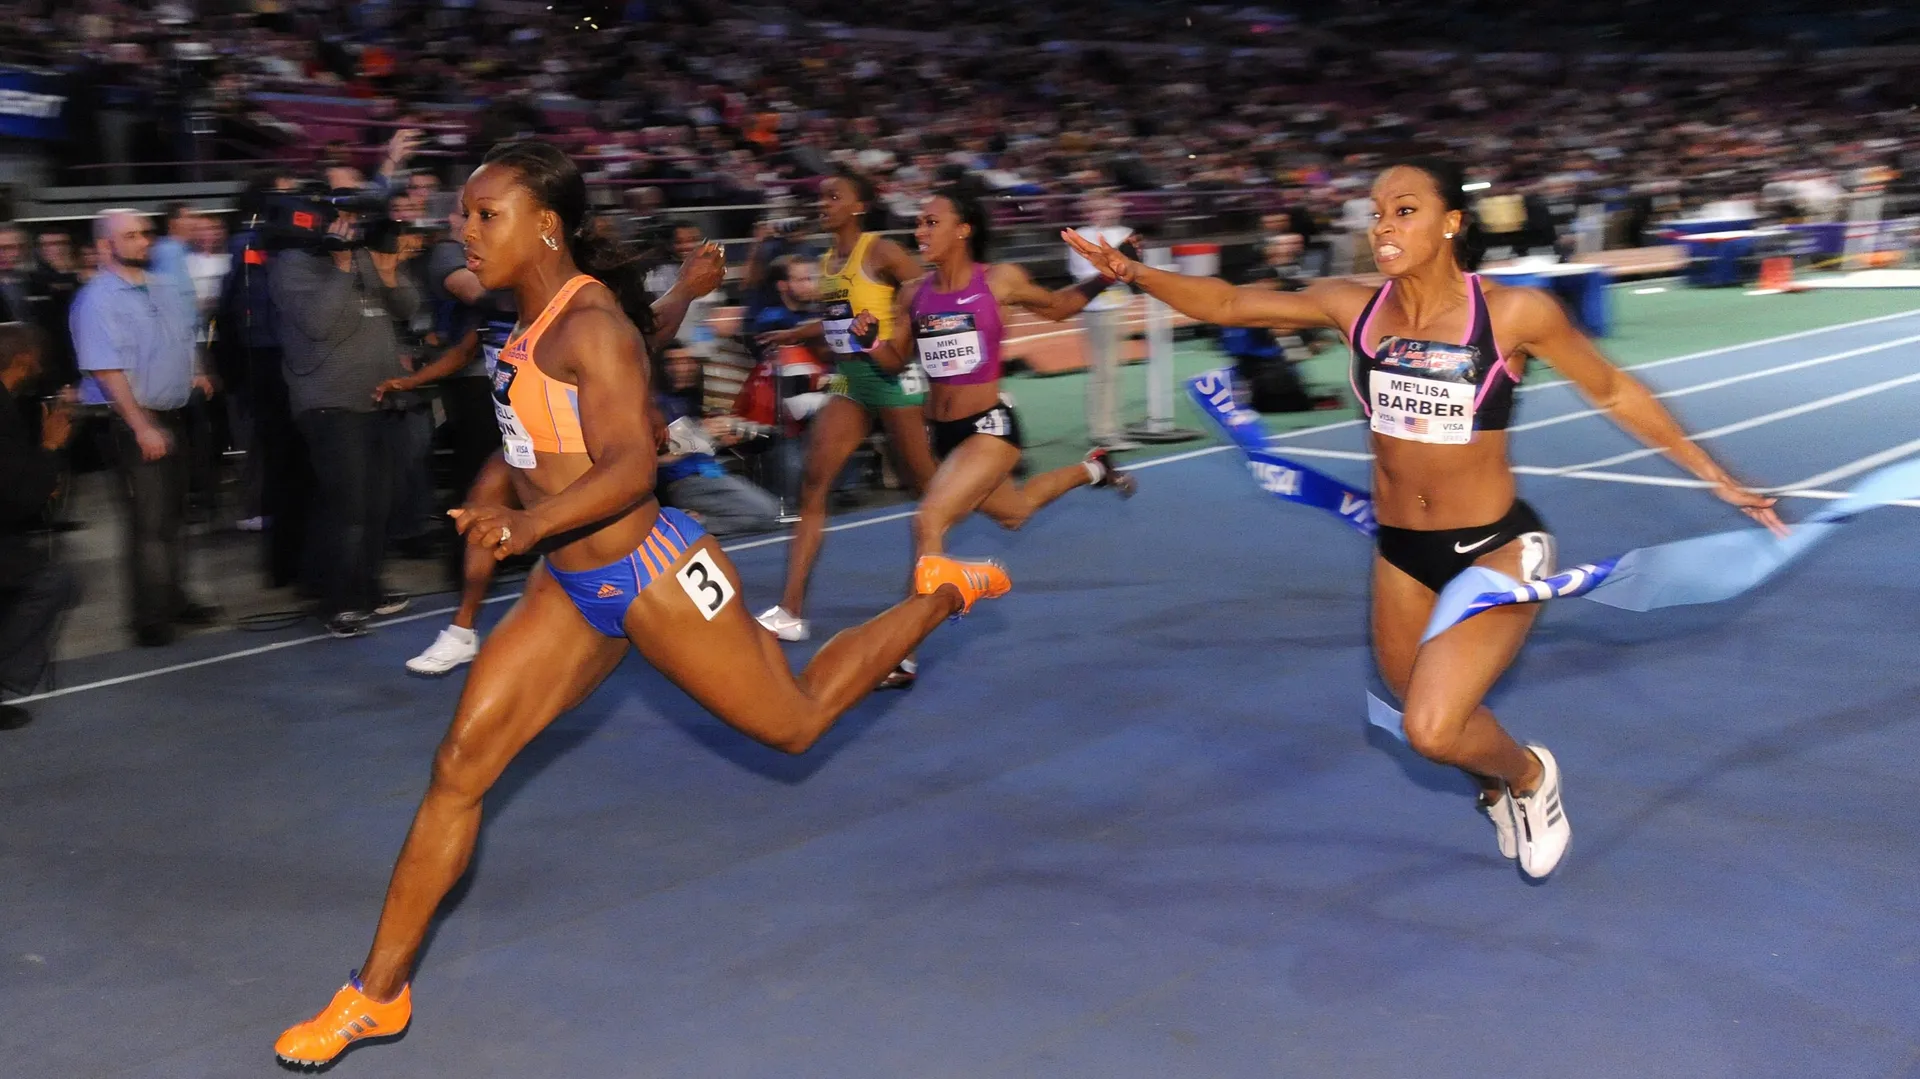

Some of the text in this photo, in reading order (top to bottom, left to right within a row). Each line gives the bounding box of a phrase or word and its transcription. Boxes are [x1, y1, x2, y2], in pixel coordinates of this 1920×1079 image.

[936, 338, 958, 348] MIKI
[924, 345, 975, 361] BARBER
[1390, 380, 1450, 399] ME'LISA
[1378, 392, 1465, 417] BARBER
[1378, 411, 1396, 423] VISA
[1442, 422, 1465, 431] VISA
[516, 445, 529, 454] VISA
[686, 561, 723, 611] 3
